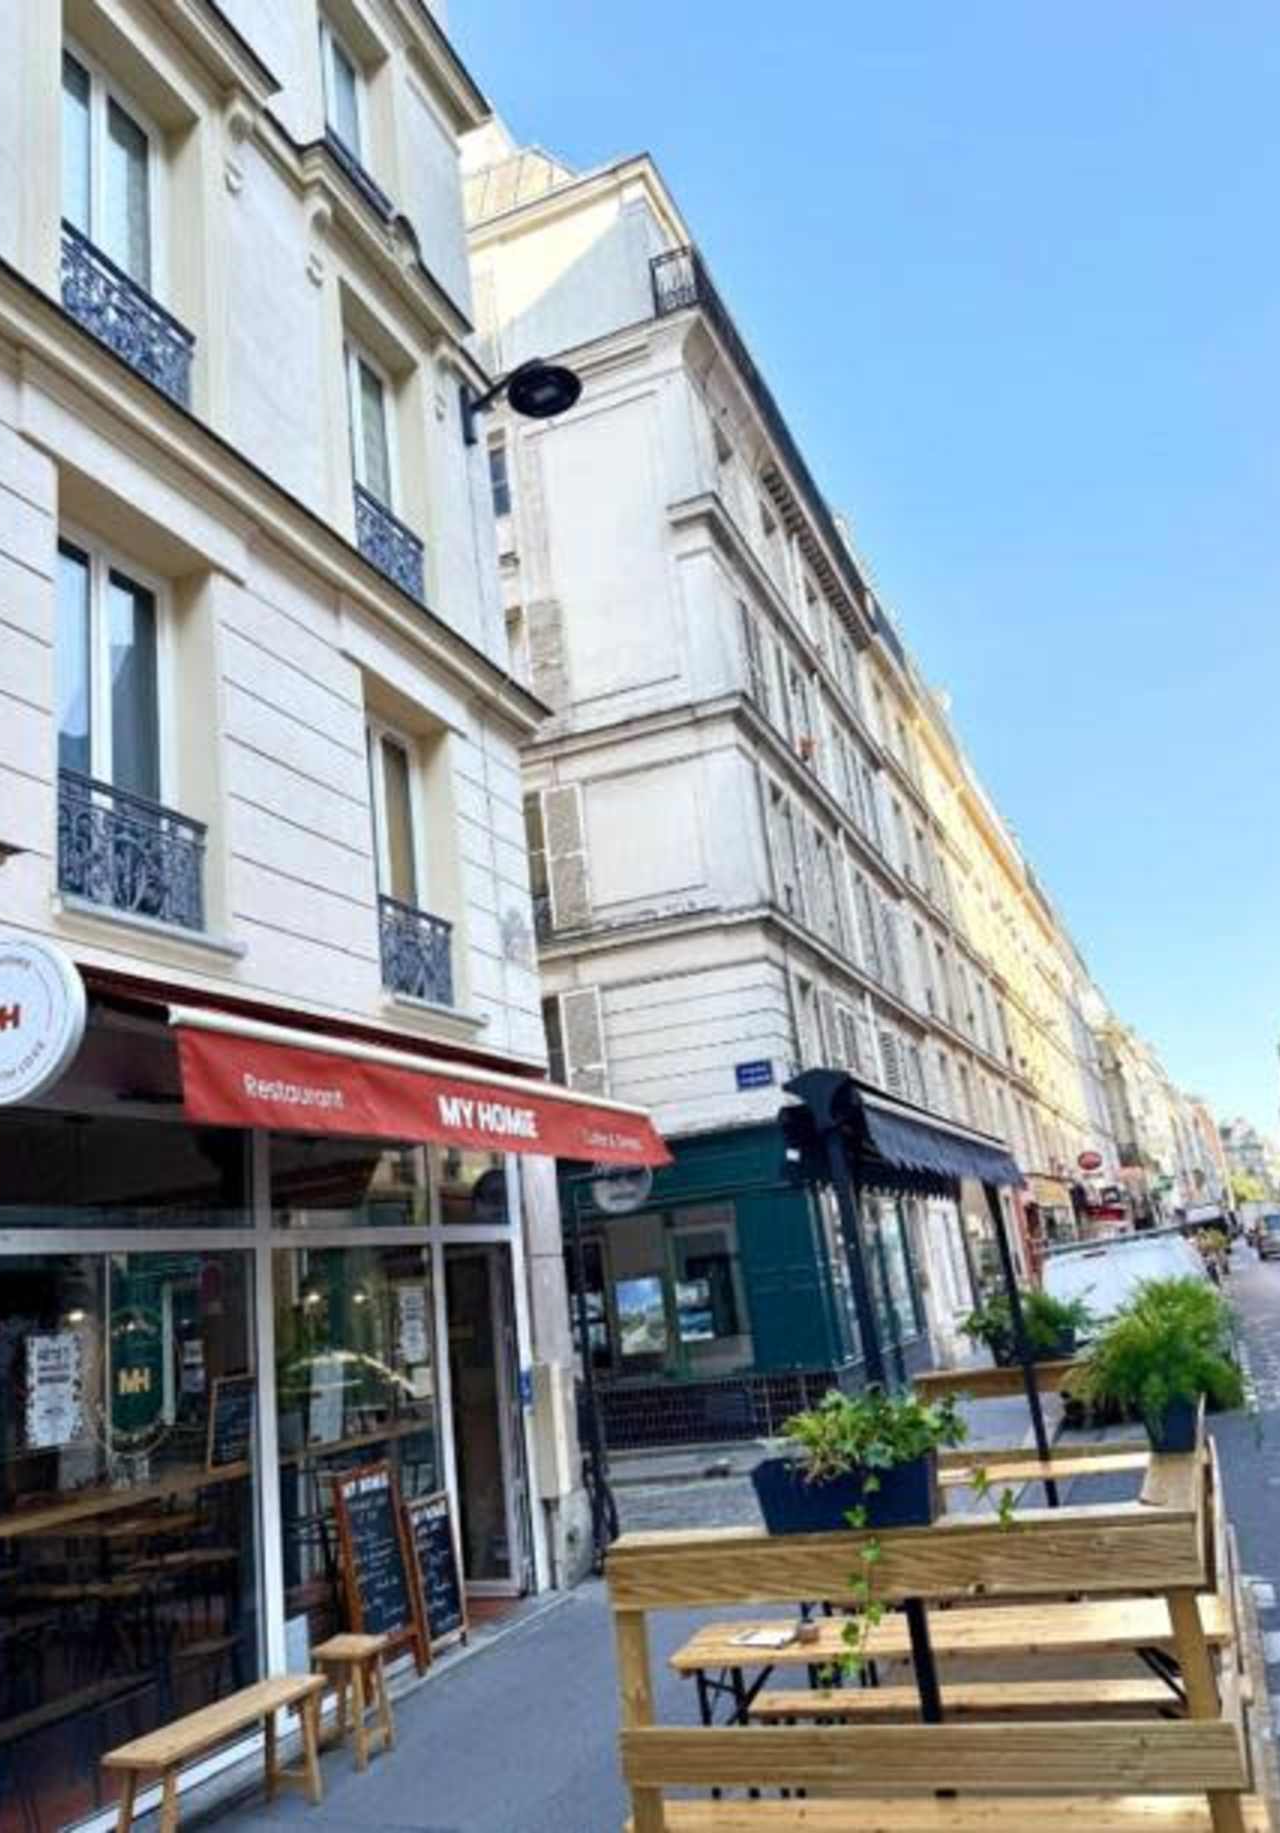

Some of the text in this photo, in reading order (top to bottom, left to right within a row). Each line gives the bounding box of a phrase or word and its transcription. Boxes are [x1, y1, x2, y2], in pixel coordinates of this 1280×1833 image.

[242, 1072, 346, 1110] Restaurant
[437, 1095, 540, 1139] MY HOMIE
[118, 1367, 152, 1394] MH
